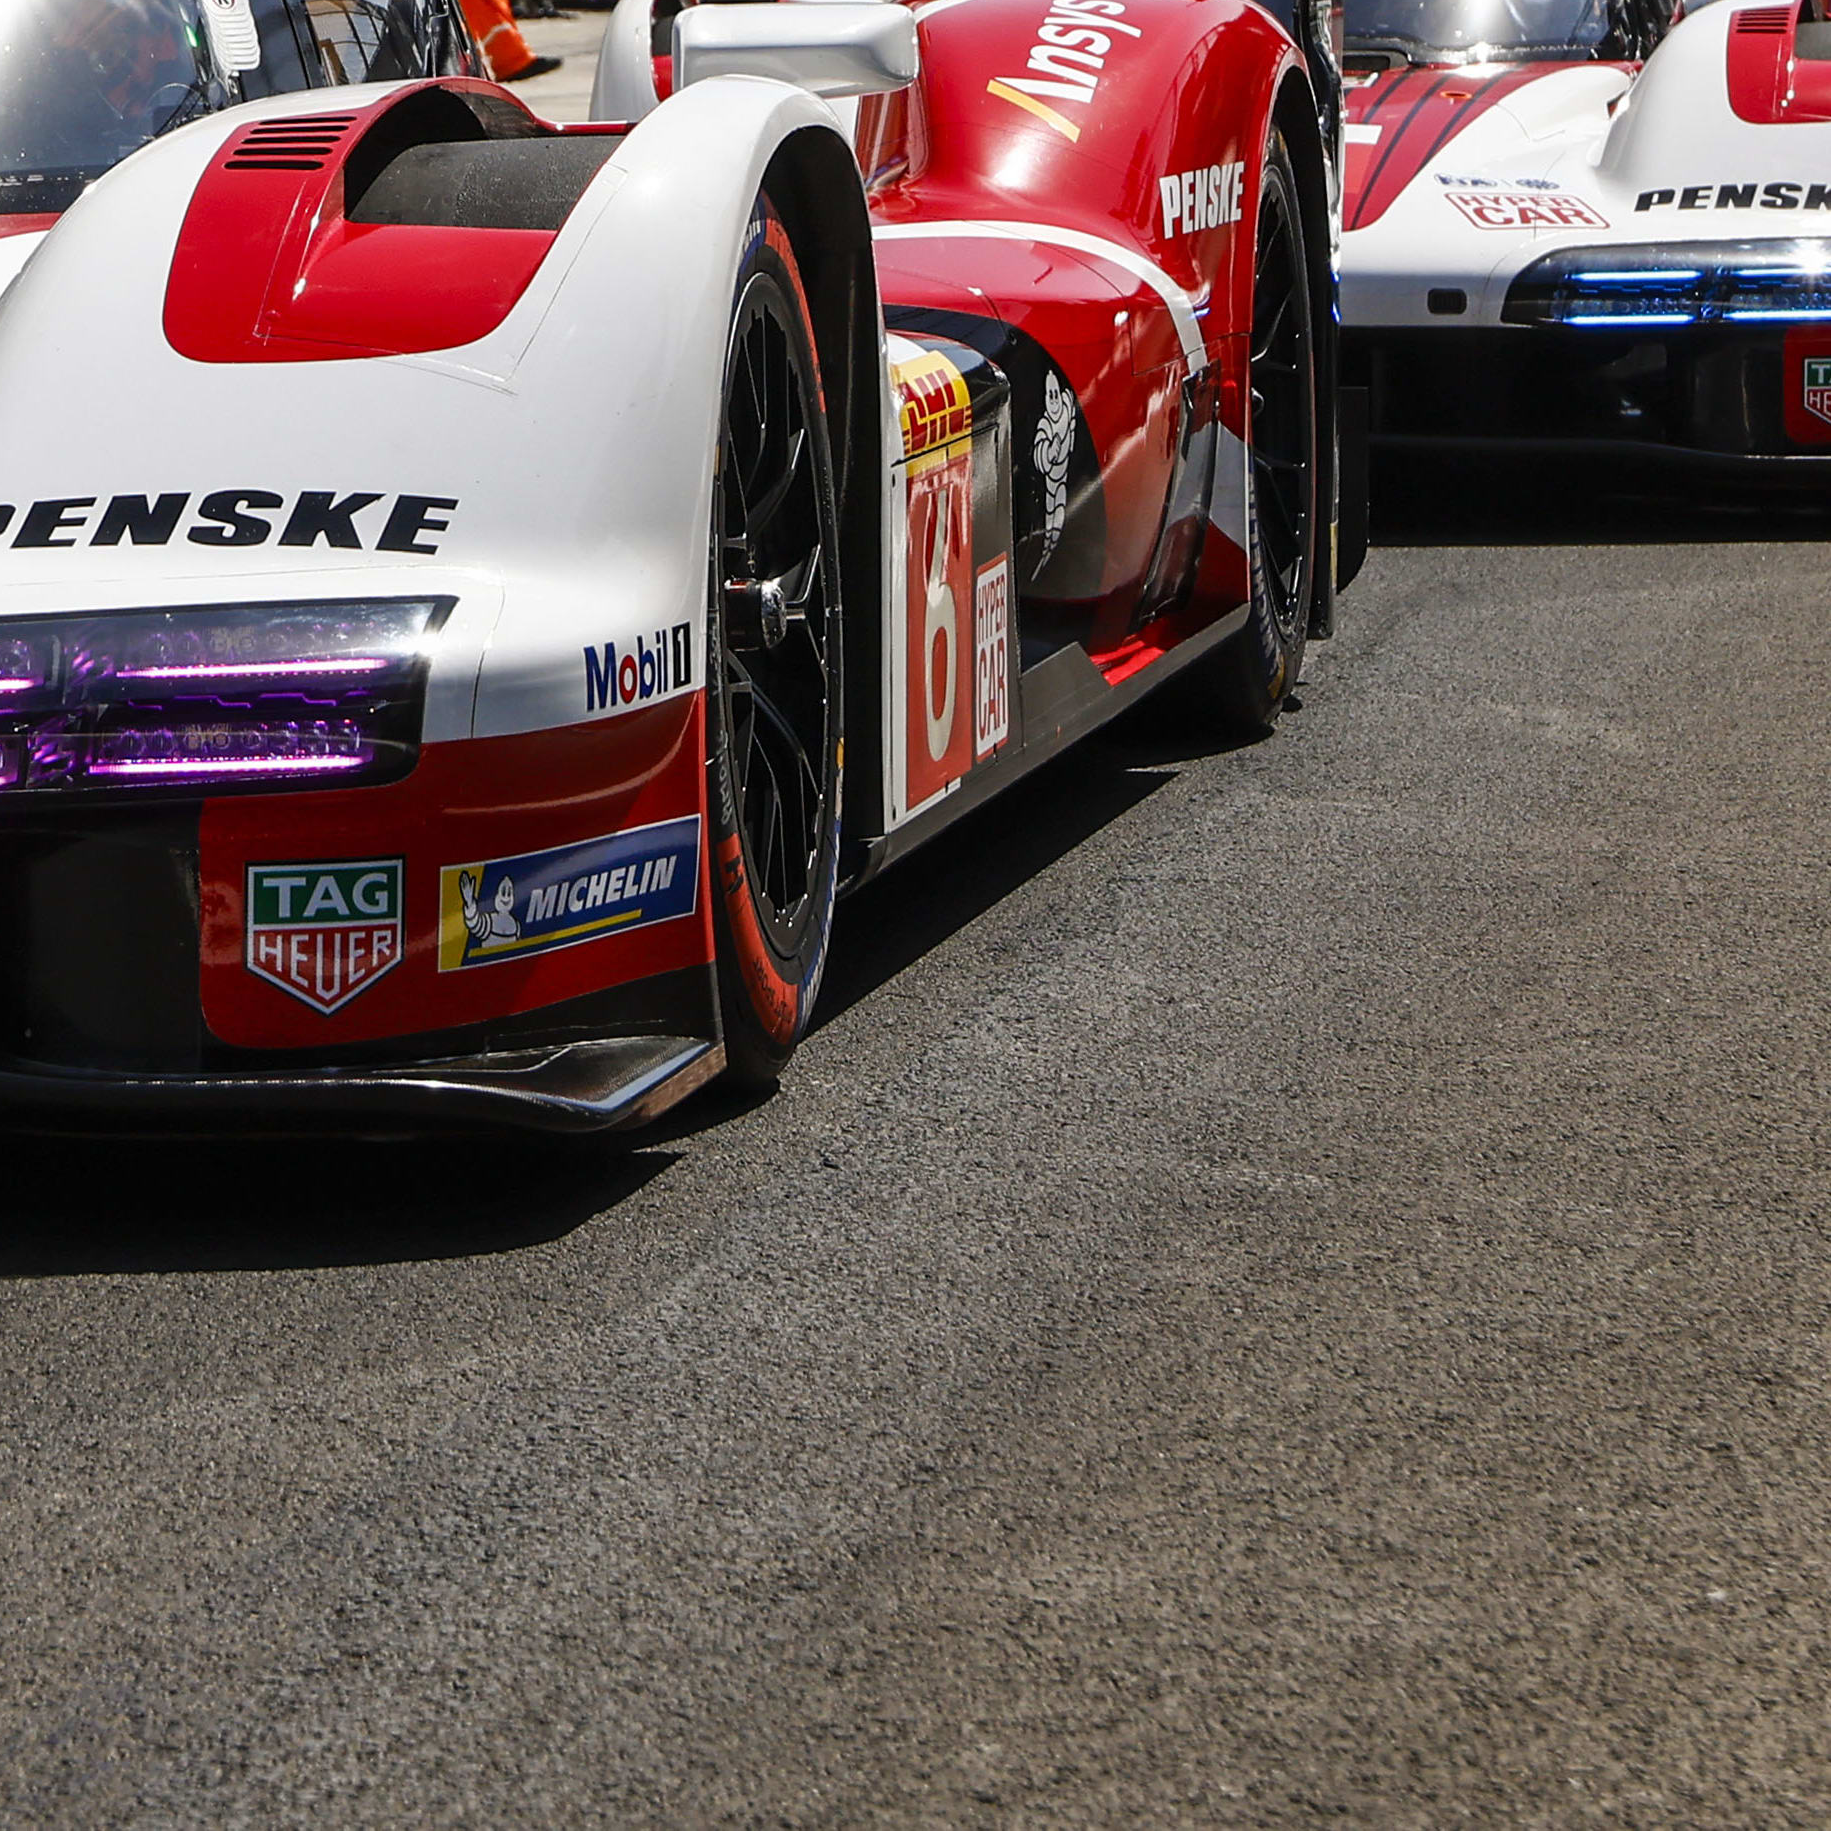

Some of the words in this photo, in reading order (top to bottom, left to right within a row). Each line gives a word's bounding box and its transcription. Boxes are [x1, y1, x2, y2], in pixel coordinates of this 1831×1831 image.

[1158, 161, 1245, 240] PENSKE
[1457, 195, 1577, 207] HYPER
[1472, 207, 1597, 226] CAR
[1634, 182, 1831, 212] PENSK
[923, 489, 957, 763] 6
[977, 574, 1006, 643] HYPER
[584, 629, 668, 711] Mobil
[977, 639, 1007, 743] CAR
[263, 873, 390, 918] TAG
[526, 854, 677, 922] MICHELIN
[258, 930, 392, 1002] HEUER
